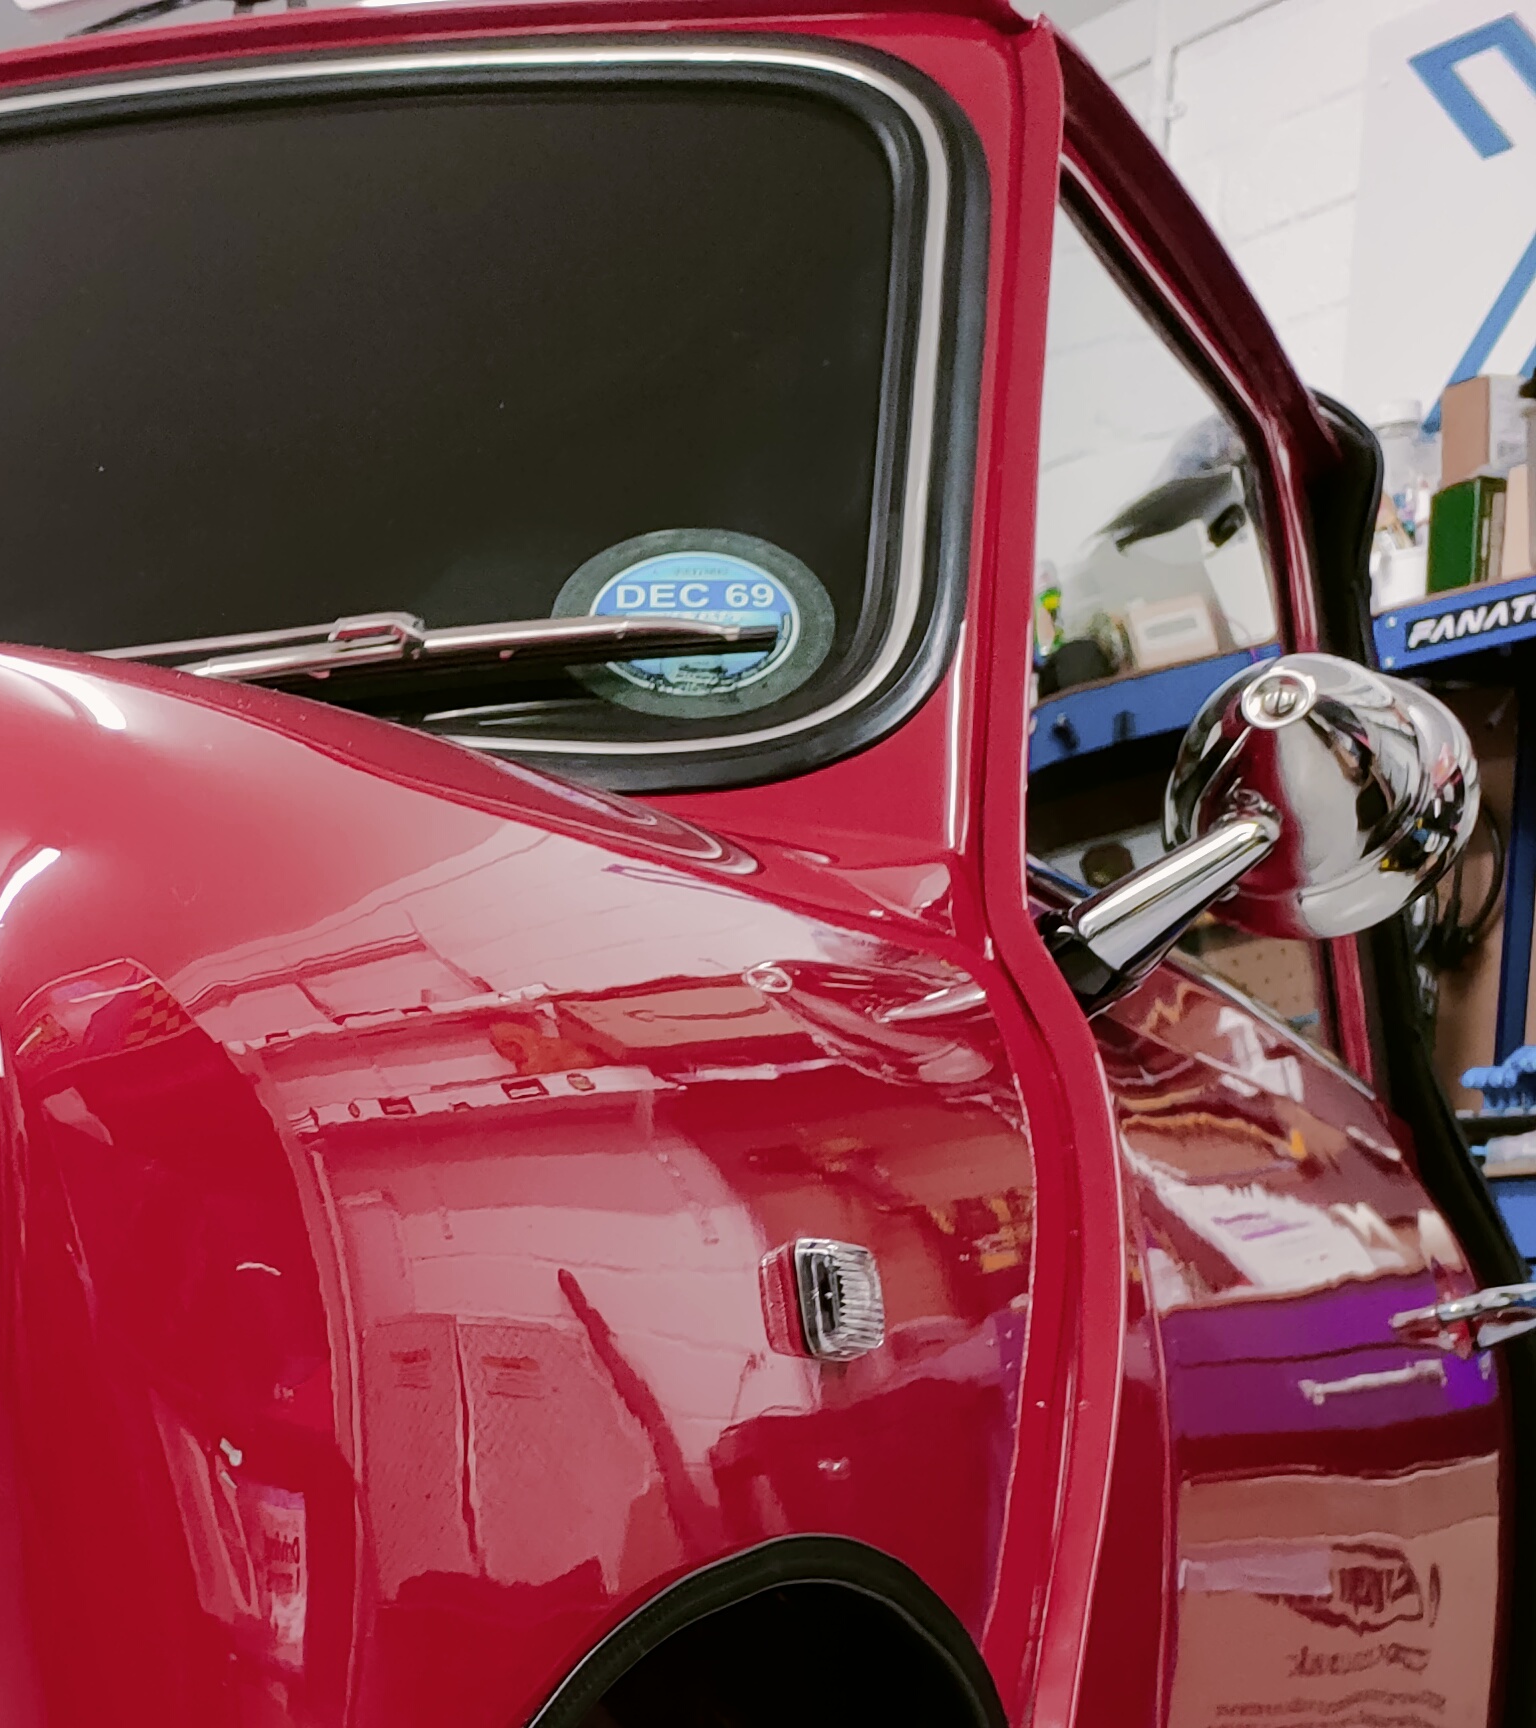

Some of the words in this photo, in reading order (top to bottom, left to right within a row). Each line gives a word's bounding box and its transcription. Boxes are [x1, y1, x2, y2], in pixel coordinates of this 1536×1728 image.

[616, 583, 710, 609] DEC
[725, 583, 775, 609] 69
[1408, 593, 1536, 648] FANAT
